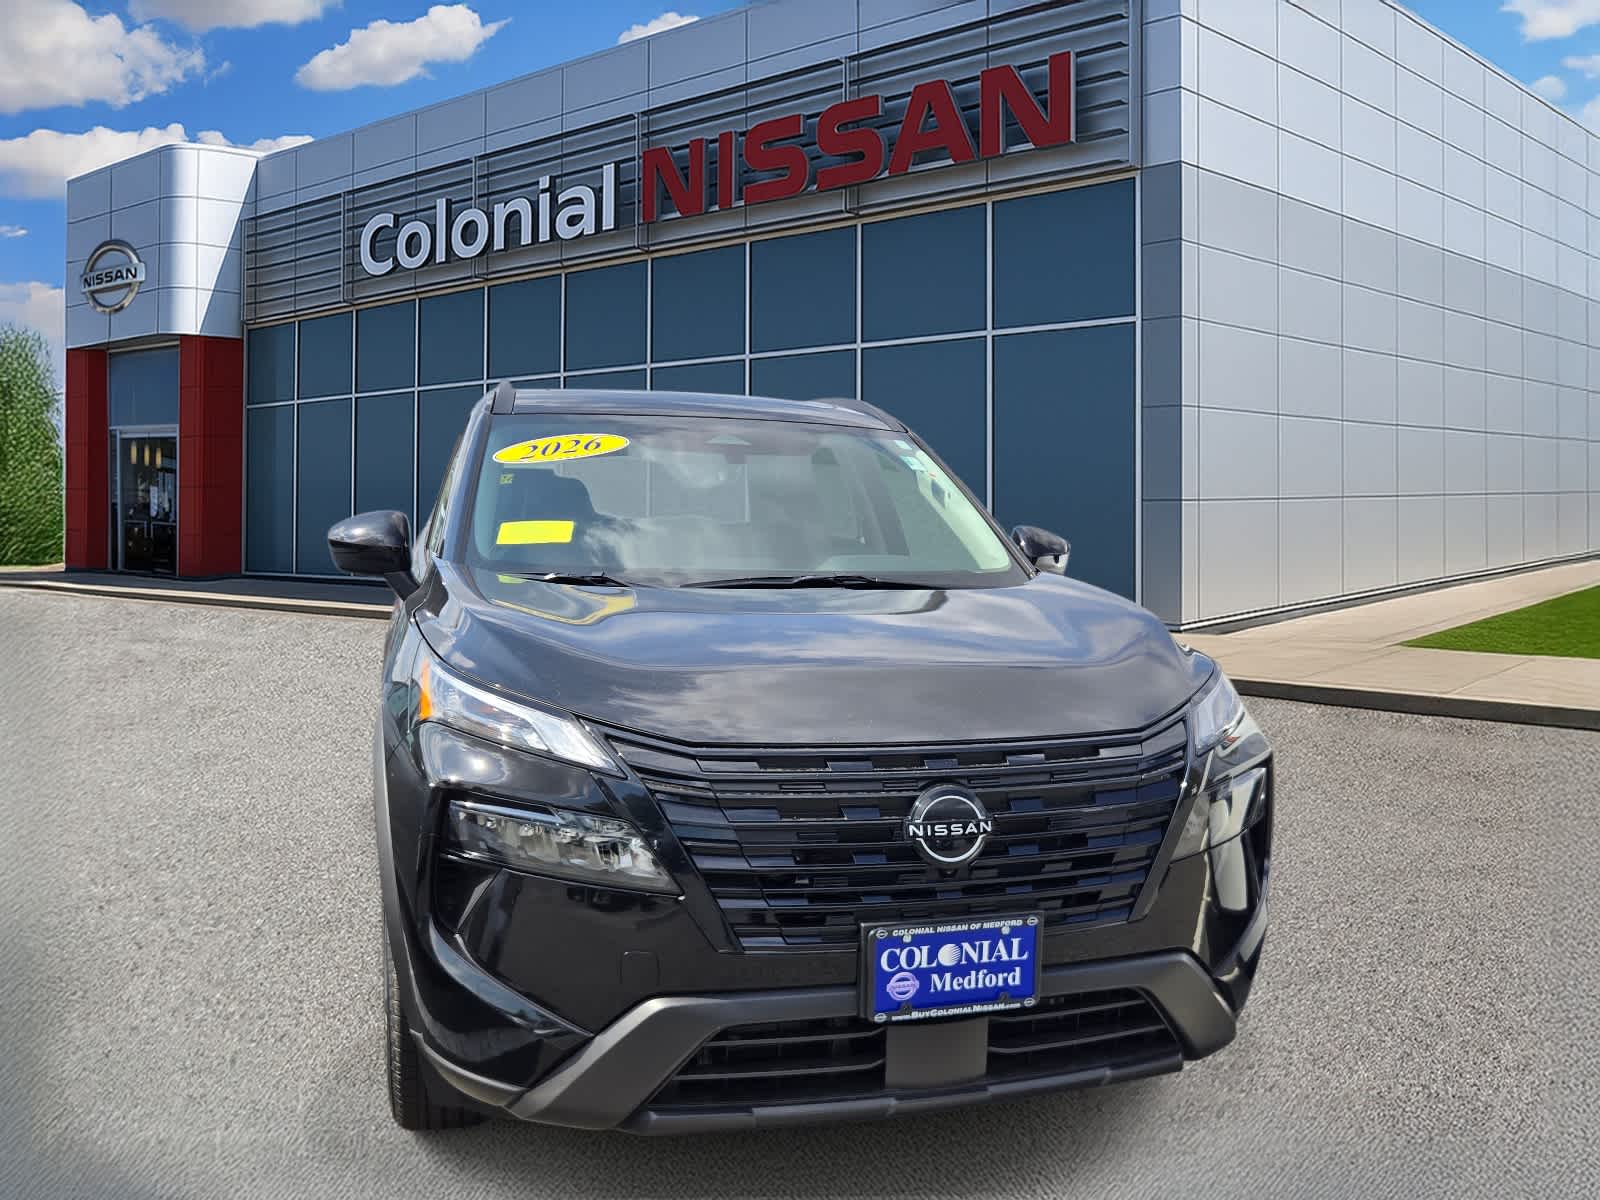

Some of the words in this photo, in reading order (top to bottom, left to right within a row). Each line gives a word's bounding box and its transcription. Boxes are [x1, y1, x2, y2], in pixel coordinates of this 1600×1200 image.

[360, 162, 617, 276] Colonial
[642, 50, 1076, 223] NISSAN
[83, 266, 137, 288] NISSAN
[519, 438, 601, 460] 2026
[908, 821, 992, 836] NISSAN
[892, 926, 935, 937] COLONIAL
[936, 923, 969, 934] NISSAN
[970, 920, 981, 931] OF
[983, 918, 1022, 930] MEDFORD
[880, 937, 1028, 972] COLONIAL
[931, 966, 1021, 992] Medford
